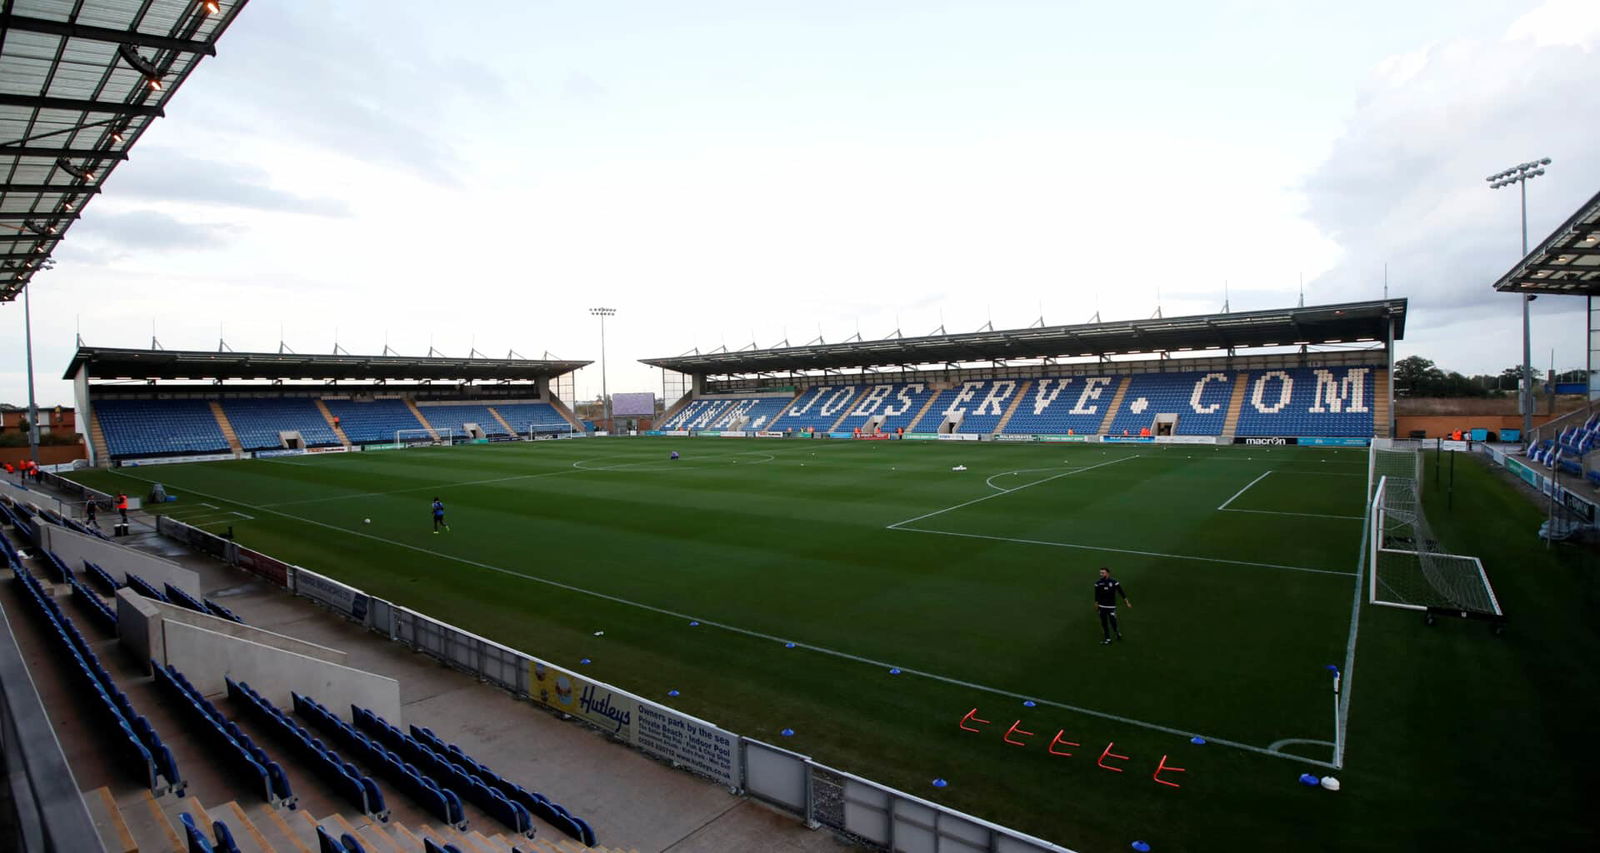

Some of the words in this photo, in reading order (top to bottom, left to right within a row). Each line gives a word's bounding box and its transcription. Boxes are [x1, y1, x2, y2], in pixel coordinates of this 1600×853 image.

[1246, 437, 1286, 446] macron
[580, 685, 630, 733] Hutleys
[639, 705, 666, 722] Owners
[668, 717, 685, 729] park
[687, 723, 697, 734] by
[699, 727, 712, 739] the
[714, 735, 730, 746] sea
[639, 716, 660, 729] Private
[662, 725, 683, 738] Beach
[689, 735, 712, 749] Indoor
[714, 745, 730, 756] Pool
